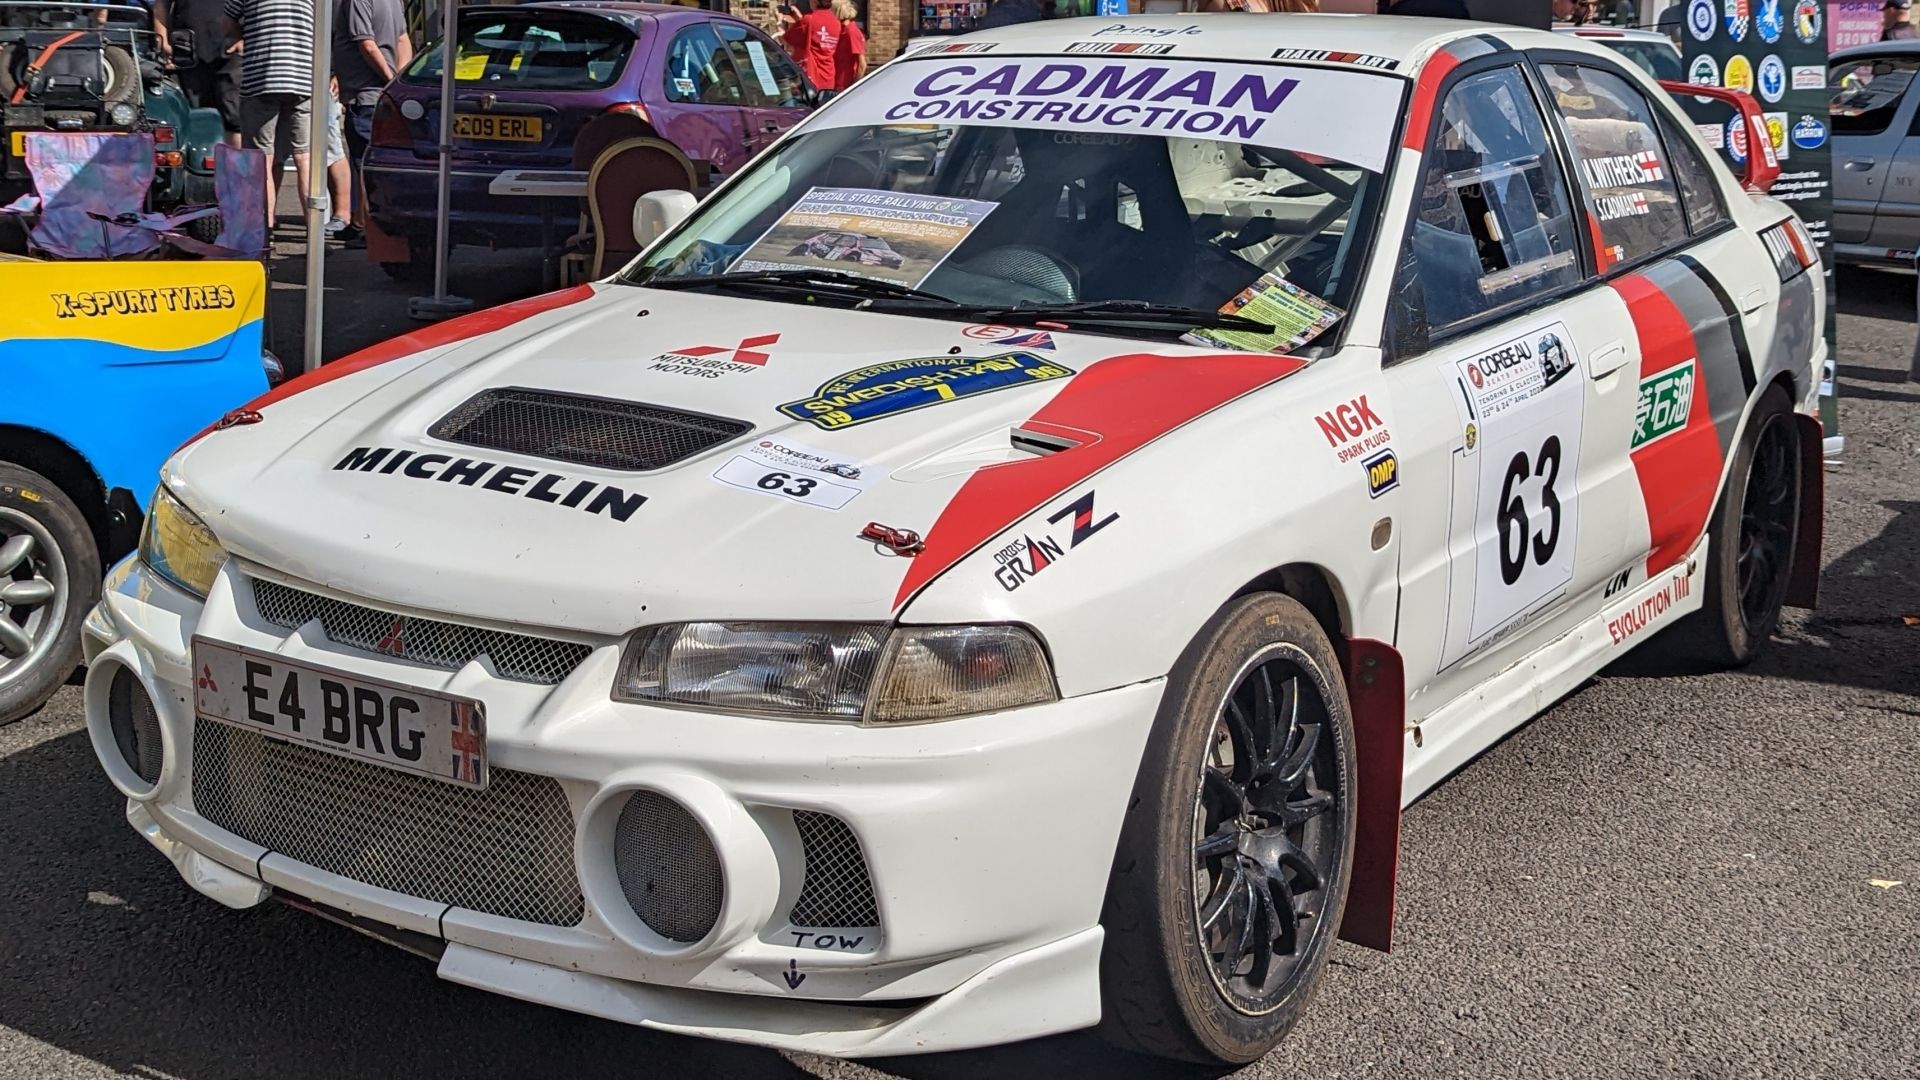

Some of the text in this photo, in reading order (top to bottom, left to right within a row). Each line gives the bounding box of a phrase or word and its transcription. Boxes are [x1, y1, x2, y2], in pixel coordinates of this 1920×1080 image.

[1091, 24, 1203, 38] Pringle
[1277, 49, 1395, 69] RALLI ART
[913, 64, 1302, 114] CADMAN
[499, 119, 534, 138] ERL
[884, 100, 1266, 140] CONSTRUCTION
[807, 191, 937, 211] SPECIAL STAGE RALLYING
[51, 285, 236, 318] X-SPURT TYRES
[647, 363, 725, 379] MOTORS
[651, 354, 758, 374] MITSUBISHI
[1478, 340, 1532, 377] CORBEAU
[803, 354, 1026, 414] SWEDISH RALLY
[817, 366, 1064, 426] 19 7 96
[1478, 388, 1508, 405] TENDRING
[1515, 374, 1541, 390] CLACTON
[1314, 394, 1384, 448] NGK
[773, 444, 829, 464] CORBEAU
[1337, 429, 1391, 463] SPARK PLUGS
[331, 447, 649, 522] MICHELIN
[757, 472, 818, 497] 63
[1370, 458, 1396, 488] OMP
[1497, 434, 1561, 586] 63
[993, 538, 1027, 565] ORBIS
[994, 533, 1065, 592] GRAN
[1608, 587, 1671, 646] EVOLUTION
[245, 660, 424, 762] E4 BRG
[791, 931, 864, 949] TOW
